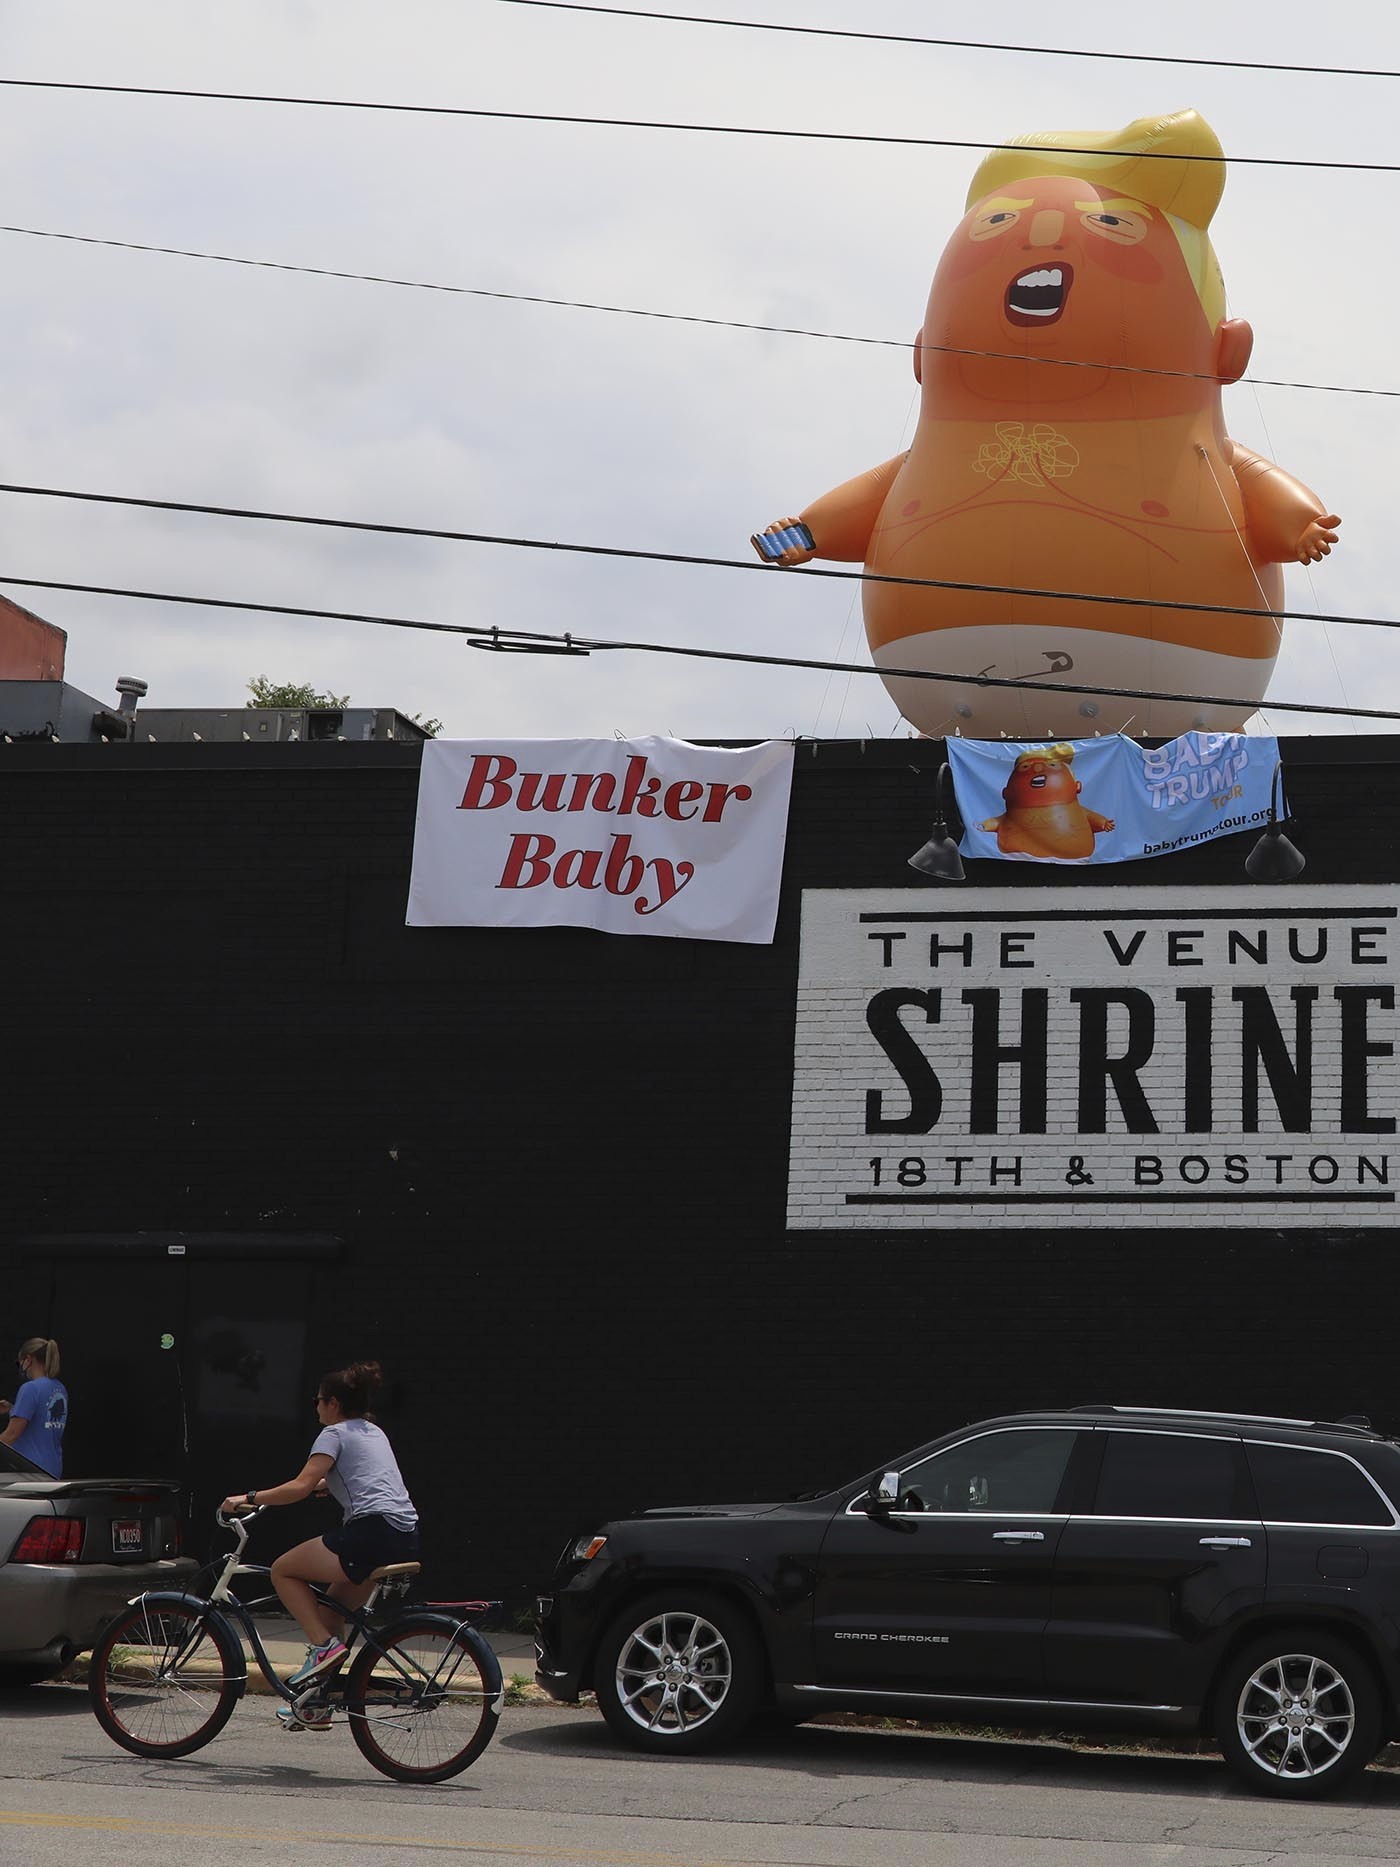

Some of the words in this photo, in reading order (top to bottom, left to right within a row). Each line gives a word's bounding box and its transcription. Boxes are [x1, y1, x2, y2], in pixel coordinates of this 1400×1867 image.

[455, 755, 753, 823] Bunker
[1146, 750, 1248, 809] TRUMP
[1211, 785, 1243, 810] TOUR
[495, 833, 695, 915] Baby
[867, 931, 1036, 969] THE
[1102, 926, 1389, 967] VENUE
[865, 984, 1398, 1136] SHRINE
[868, 1155, 1023, 1188] 18TH
[1064, 1155, 1095, 1187] &
[1133, 1154, 1390, 1186] BOSTON
[834, 1632, 878, 1640] GRAND
[880, 1634, 949, 1643] CHEROKEE
